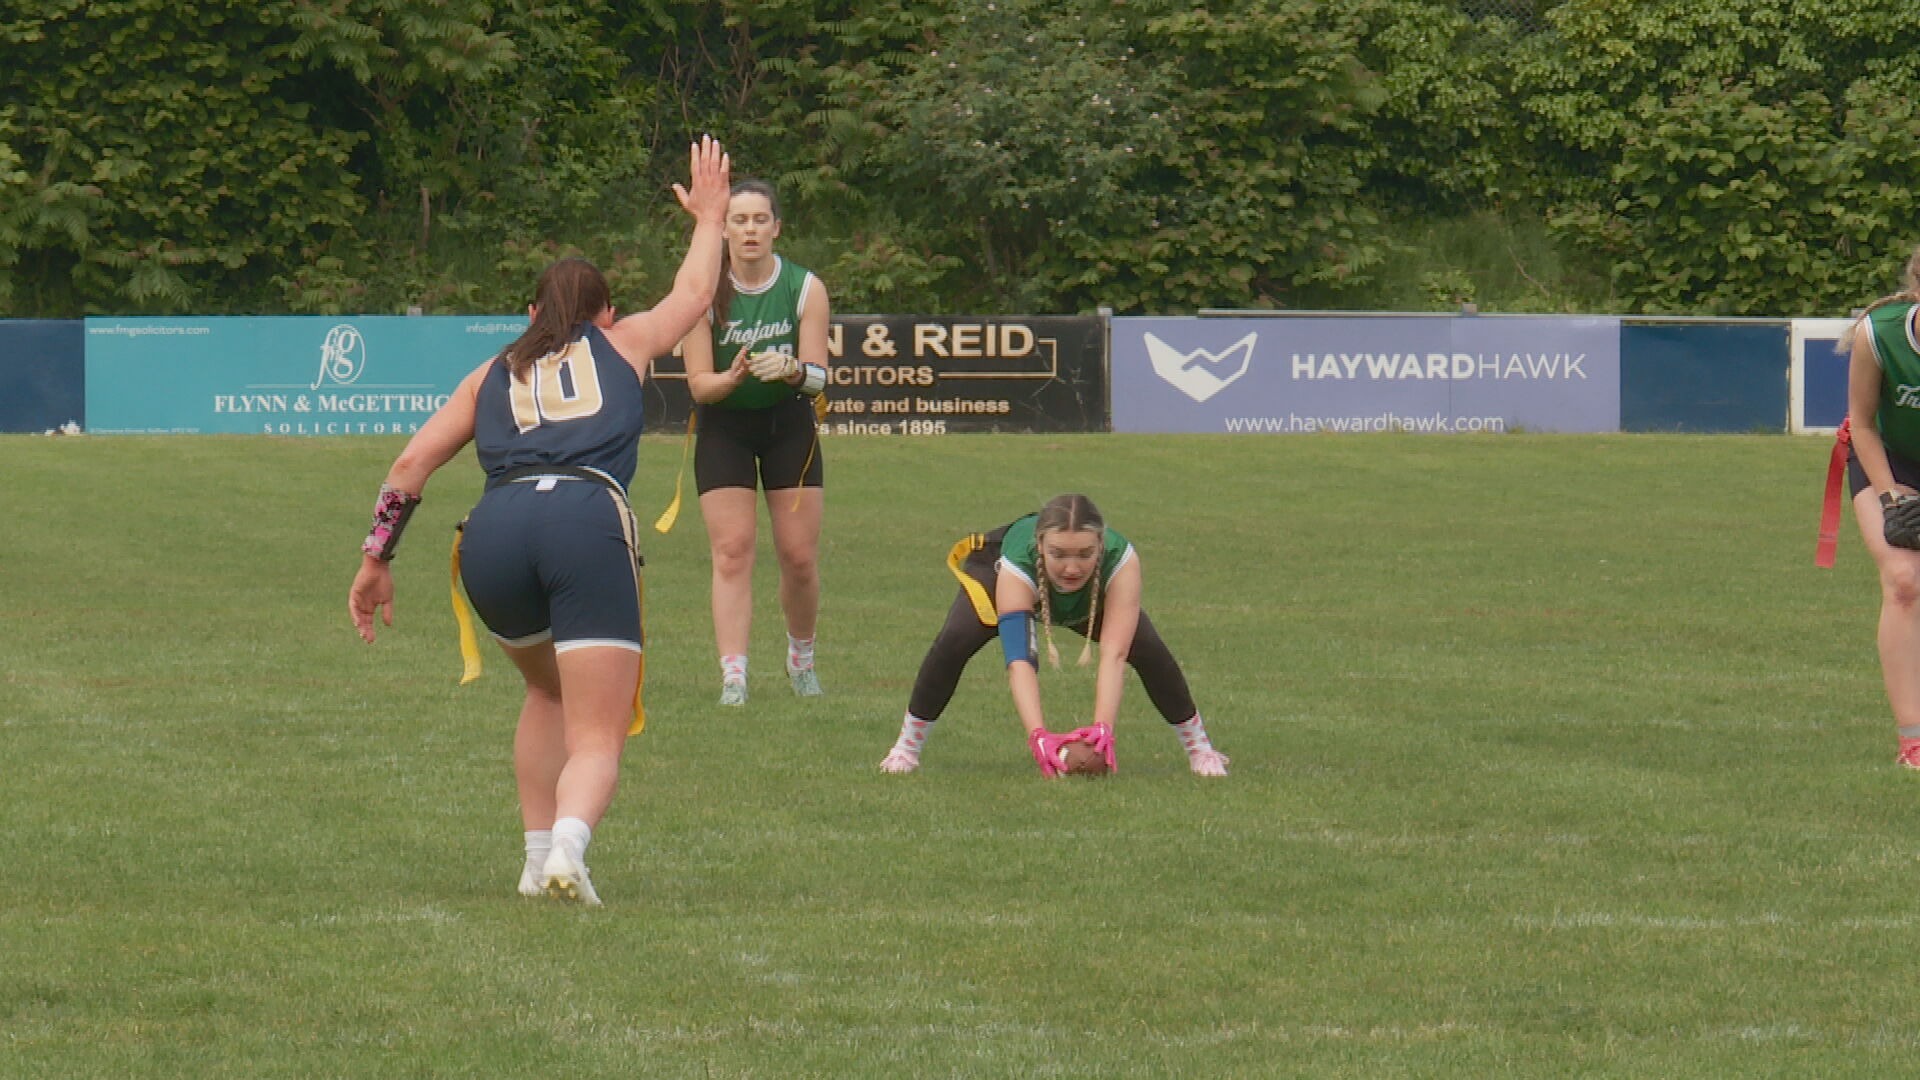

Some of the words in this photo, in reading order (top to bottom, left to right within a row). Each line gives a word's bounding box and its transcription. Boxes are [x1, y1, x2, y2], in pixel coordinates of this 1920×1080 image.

[718, 317, 793, 350] Trojans
[914, 323, 1034, 357] REID
[827, 366, 934, 385] ICITORS
[1291, 353, 1588, 380] HAYWARDHAWK
[507, 336, 603, 434] 10
[214, 394, 288, 413] FLYNN
[293, 394, 311, 413] &
[318, 394, 449, 413] McGETTRIC
[871, 397, 909, 413] and
[916, 397, 1010, 413] business
[263, 422, 418, 435] SOLICITORS
[837, 419, 892, 435] since
[899, 419, 947, 435] 1895
[1224, 411, 1505, 433] www.haywardhawk.com
